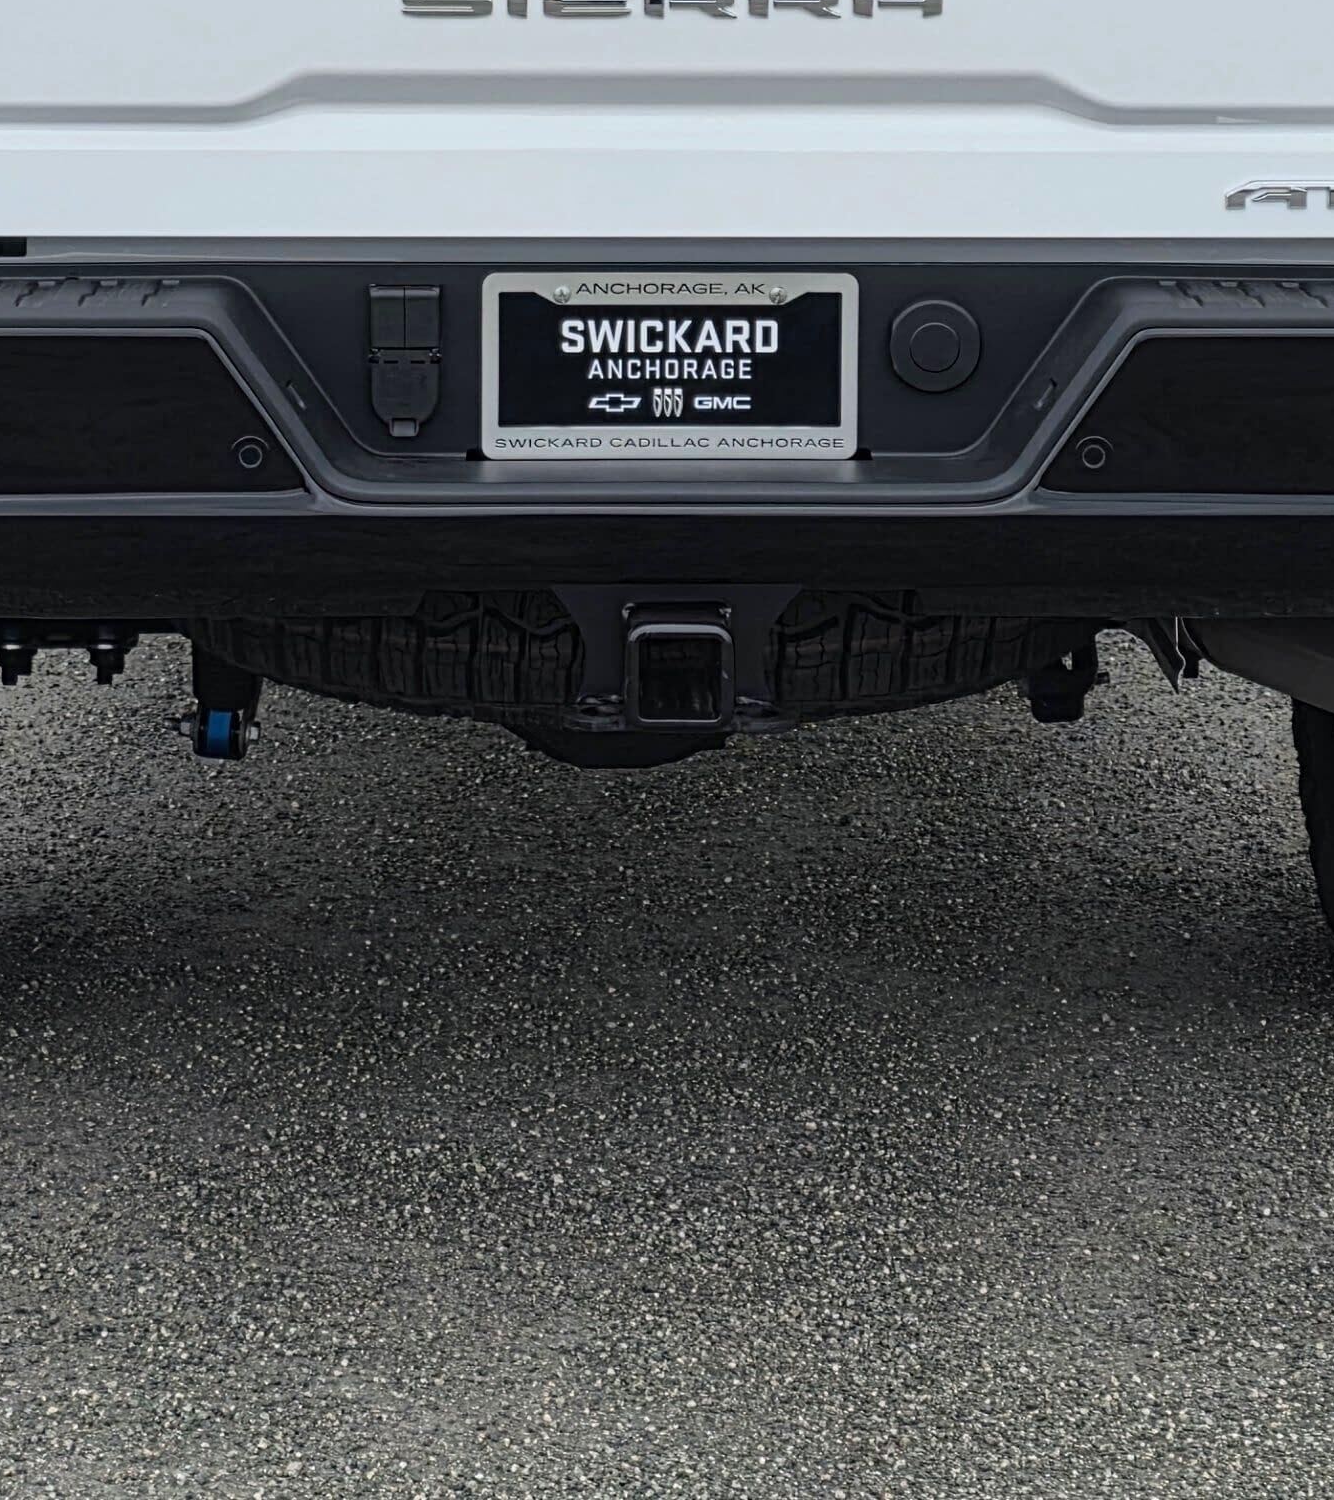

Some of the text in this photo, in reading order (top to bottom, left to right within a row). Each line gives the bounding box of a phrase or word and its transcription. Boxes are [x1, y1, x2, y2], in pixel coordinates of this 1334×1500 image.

[576, 283, 765, 295] ANCHORAGE, AK
[561, 320, 778, 353] SWICKARD
[588, 359, 752, 379] ANCHORAGE
[694, 397, 751, 409] GMC
[494, 438, 845, 448] SWICKARD CADILLAC ANCHORAGE
